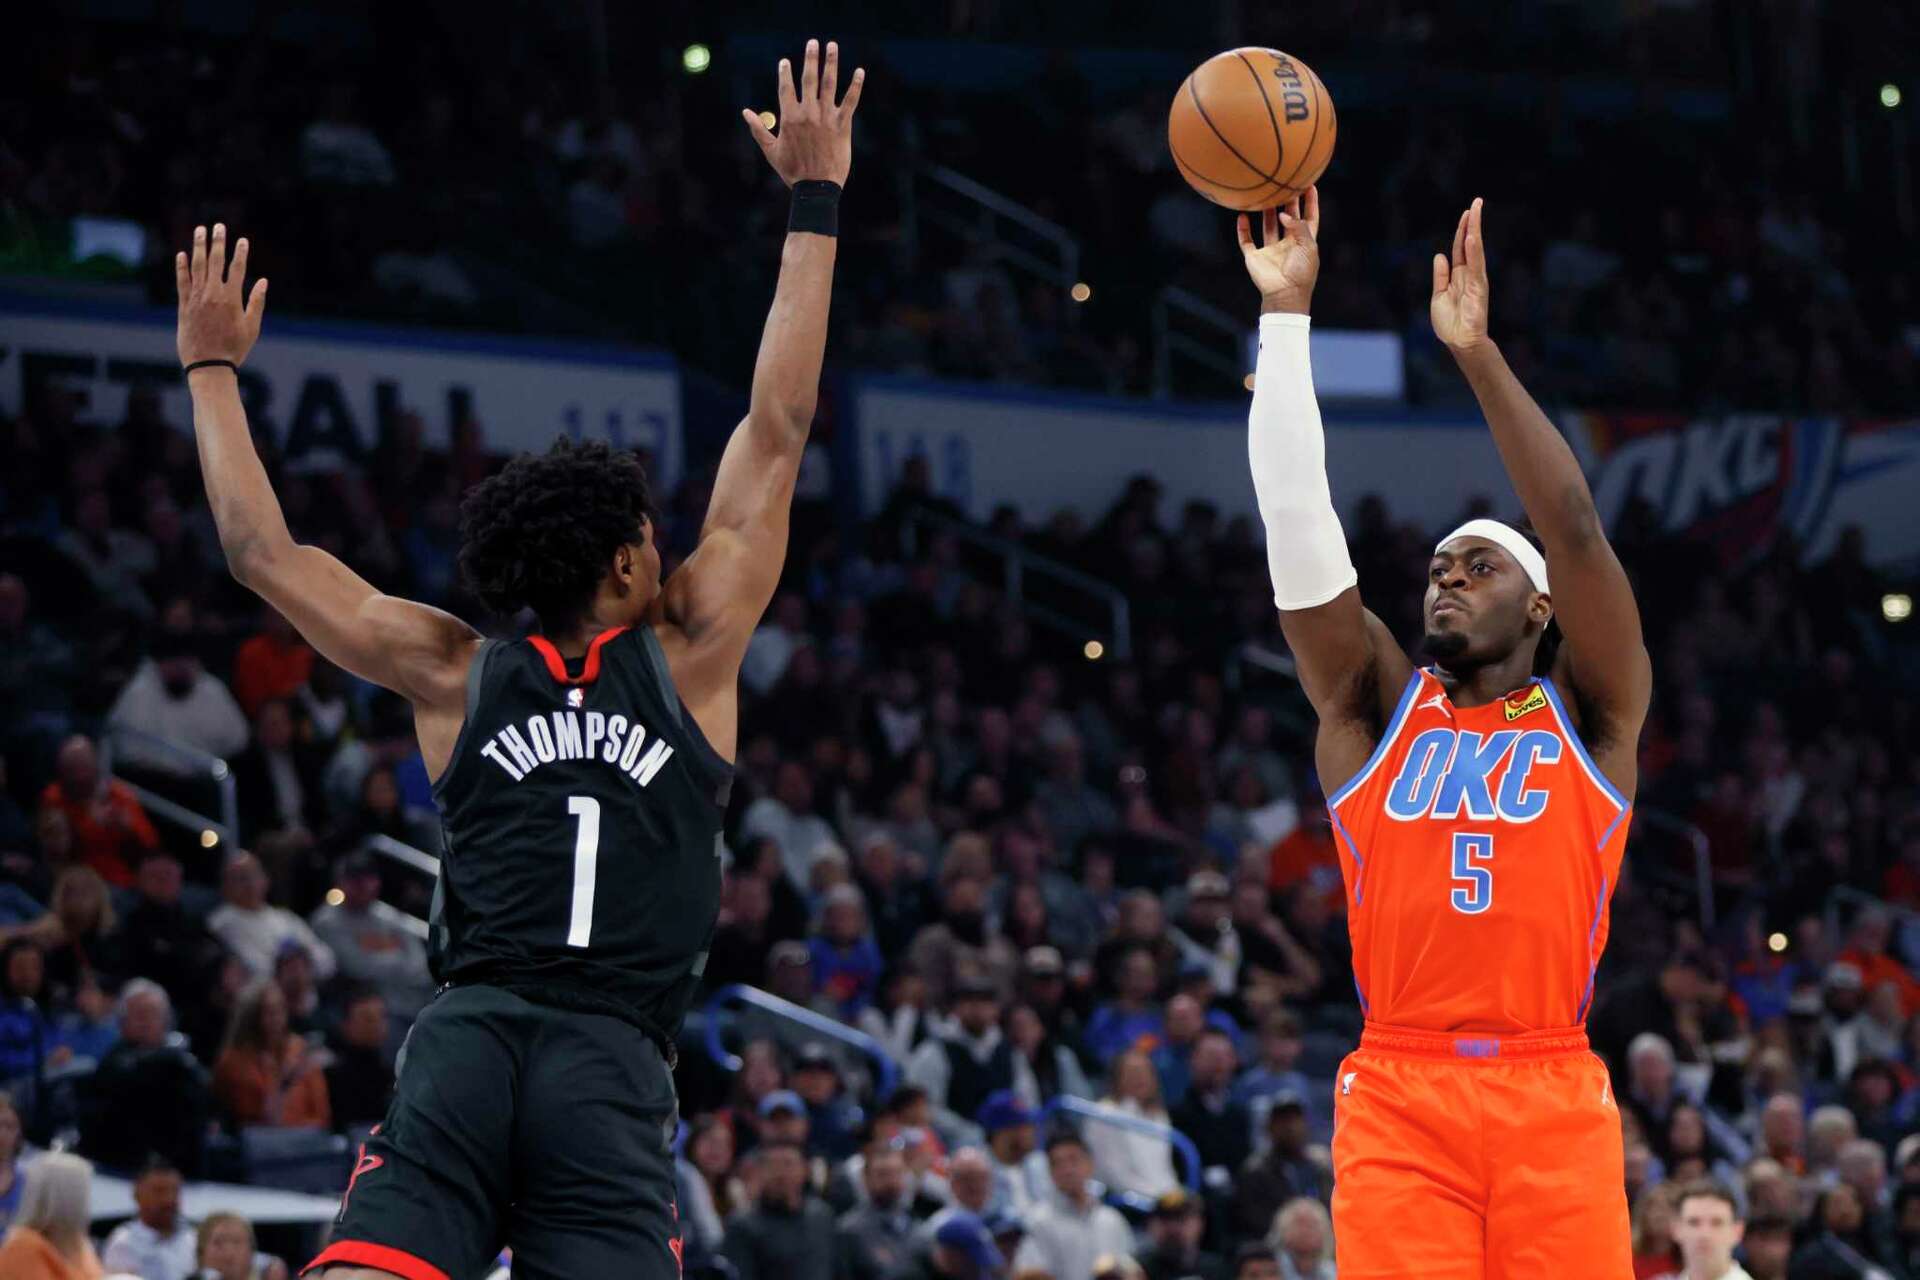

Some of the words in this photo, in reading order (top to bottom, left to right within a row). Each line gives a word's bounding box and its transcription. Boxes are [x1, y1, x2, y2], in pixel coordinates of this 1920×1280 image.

[481, 711, 674, 787] THOMPSON
[1385, 729, 1563, 822] OKC
[567, 796, 600, 948] 1
[1451, 832, 1493, 914] 5
